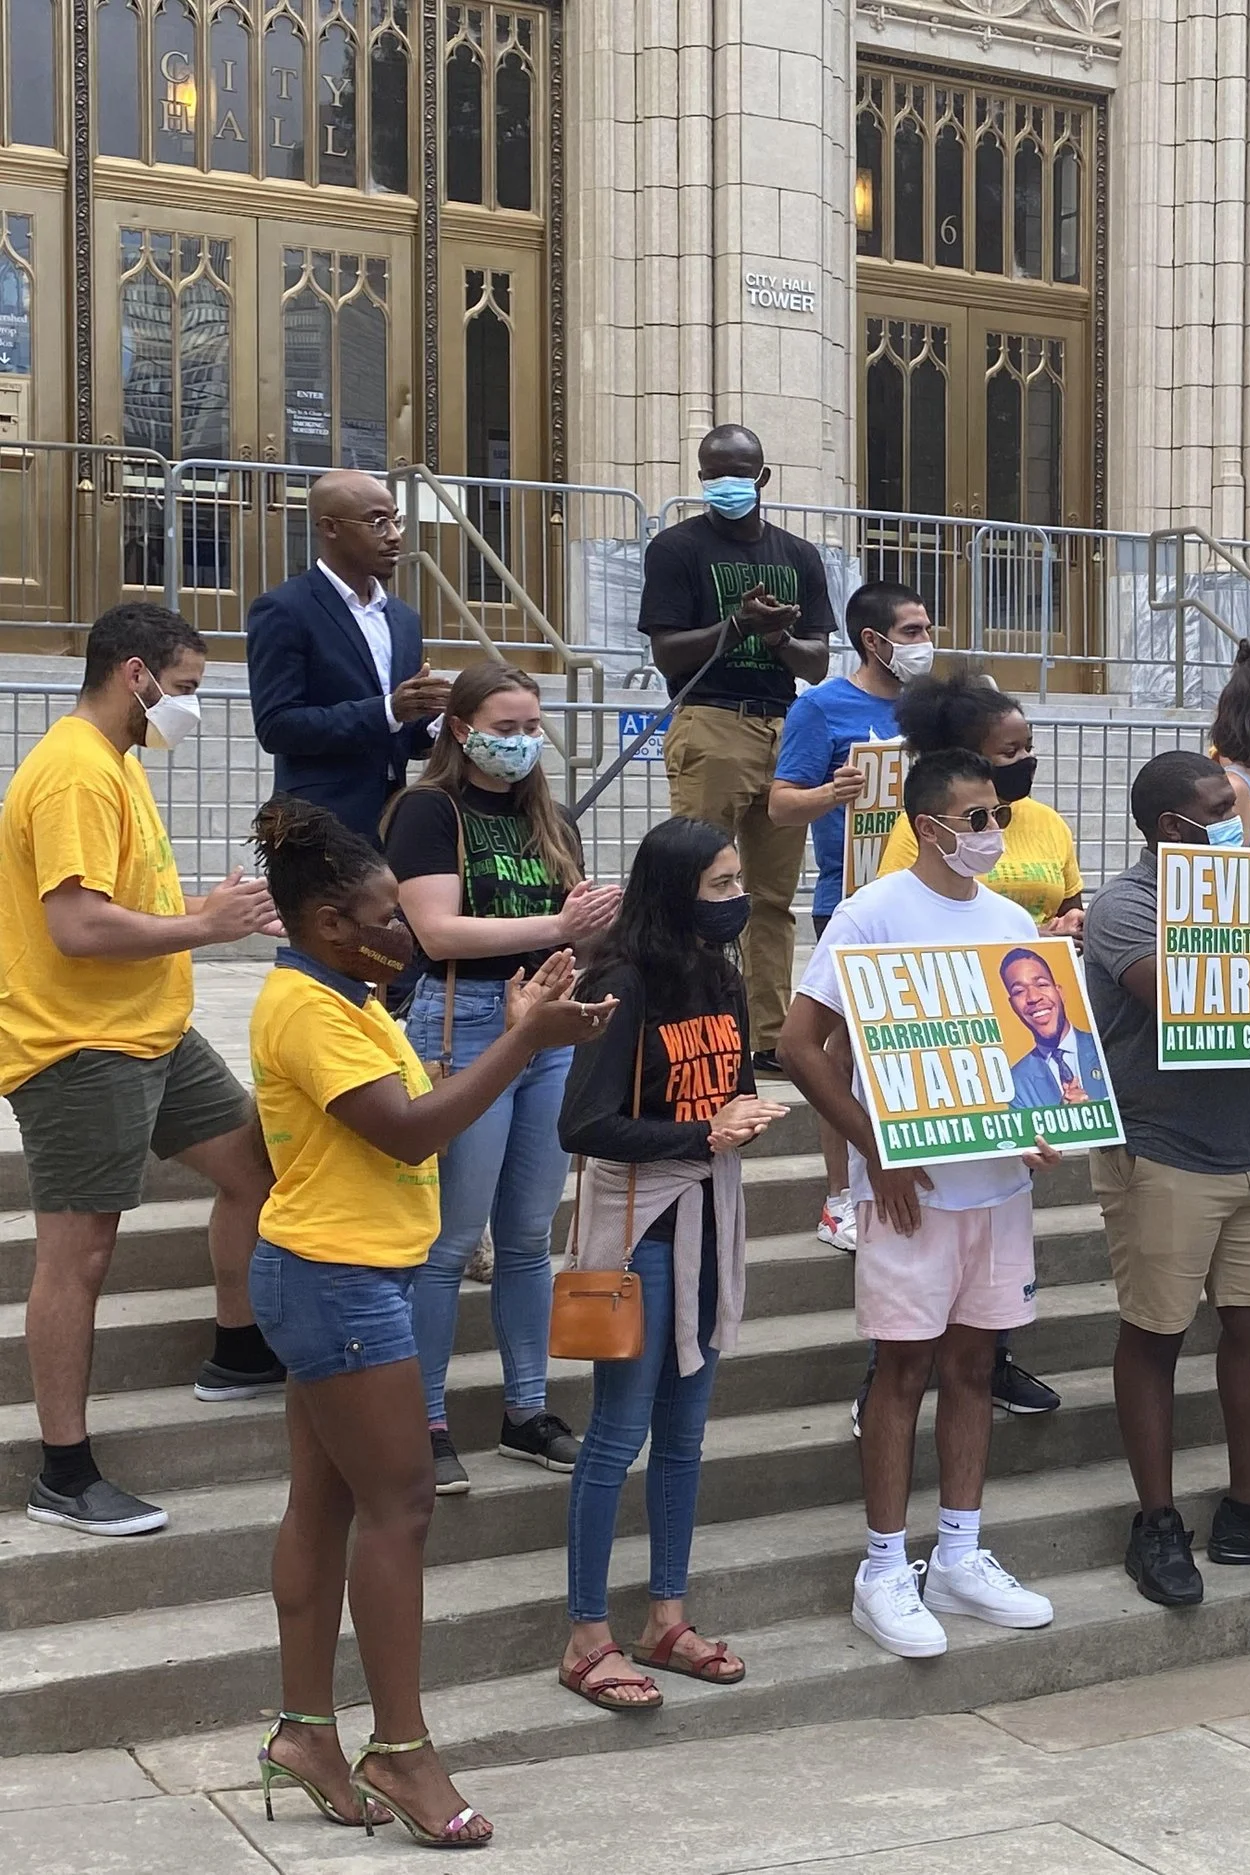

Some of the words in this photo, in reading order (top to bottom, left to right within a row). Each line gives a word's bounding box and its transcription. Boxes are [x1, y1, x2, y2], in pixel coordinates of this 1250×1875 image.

[160, 50, 351, 107] CITY
[159, 99, 348, 157] HALL
[940, 214, 957, 245] 6
[745, 272, 777, 289] CITY
[781, 277, 815, 294] HALL
[747, 287, 815, 313] TOWER
[296, 390, 324, 400] ENTER
[843, 951, 995, 1021] DEVIN
[862, 1018, 1002, 1052] BARRINGTON
[1166, 1024, 1236, 1050] ATLANTA
[870, 1046, 1016, 1113] WARD
[886, 1117, 976, 1150] ATLANTA
[982, 1112, 1024, 1140] CITY
[1031, 1104, 1112, 1135] COUNCIL
